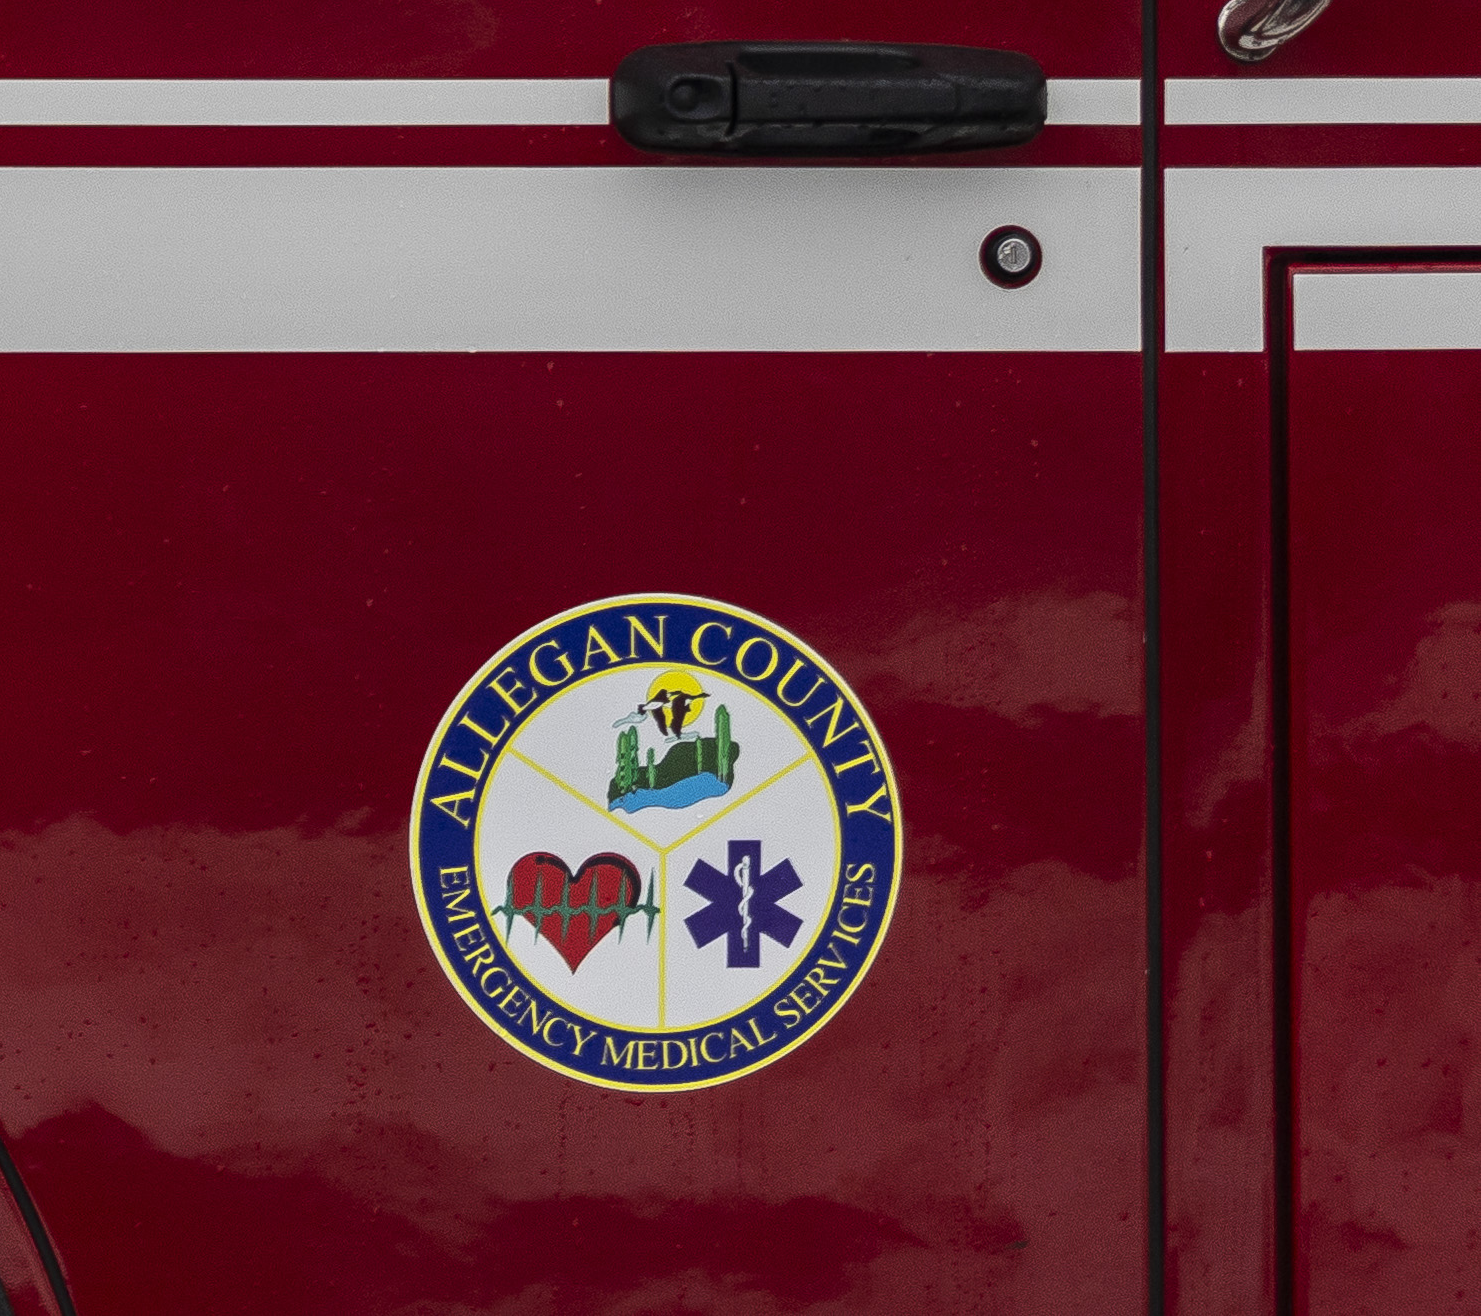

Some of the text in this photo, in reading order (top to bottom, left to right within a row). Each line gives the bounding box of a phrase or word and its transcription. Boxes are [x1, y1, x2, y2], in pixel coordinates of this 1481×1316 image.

[430, 614, 893, 829] ALLEGAN COUNTY
[440, 862, 877, 1071] EMERGENCY MEDICAL SERVICES
